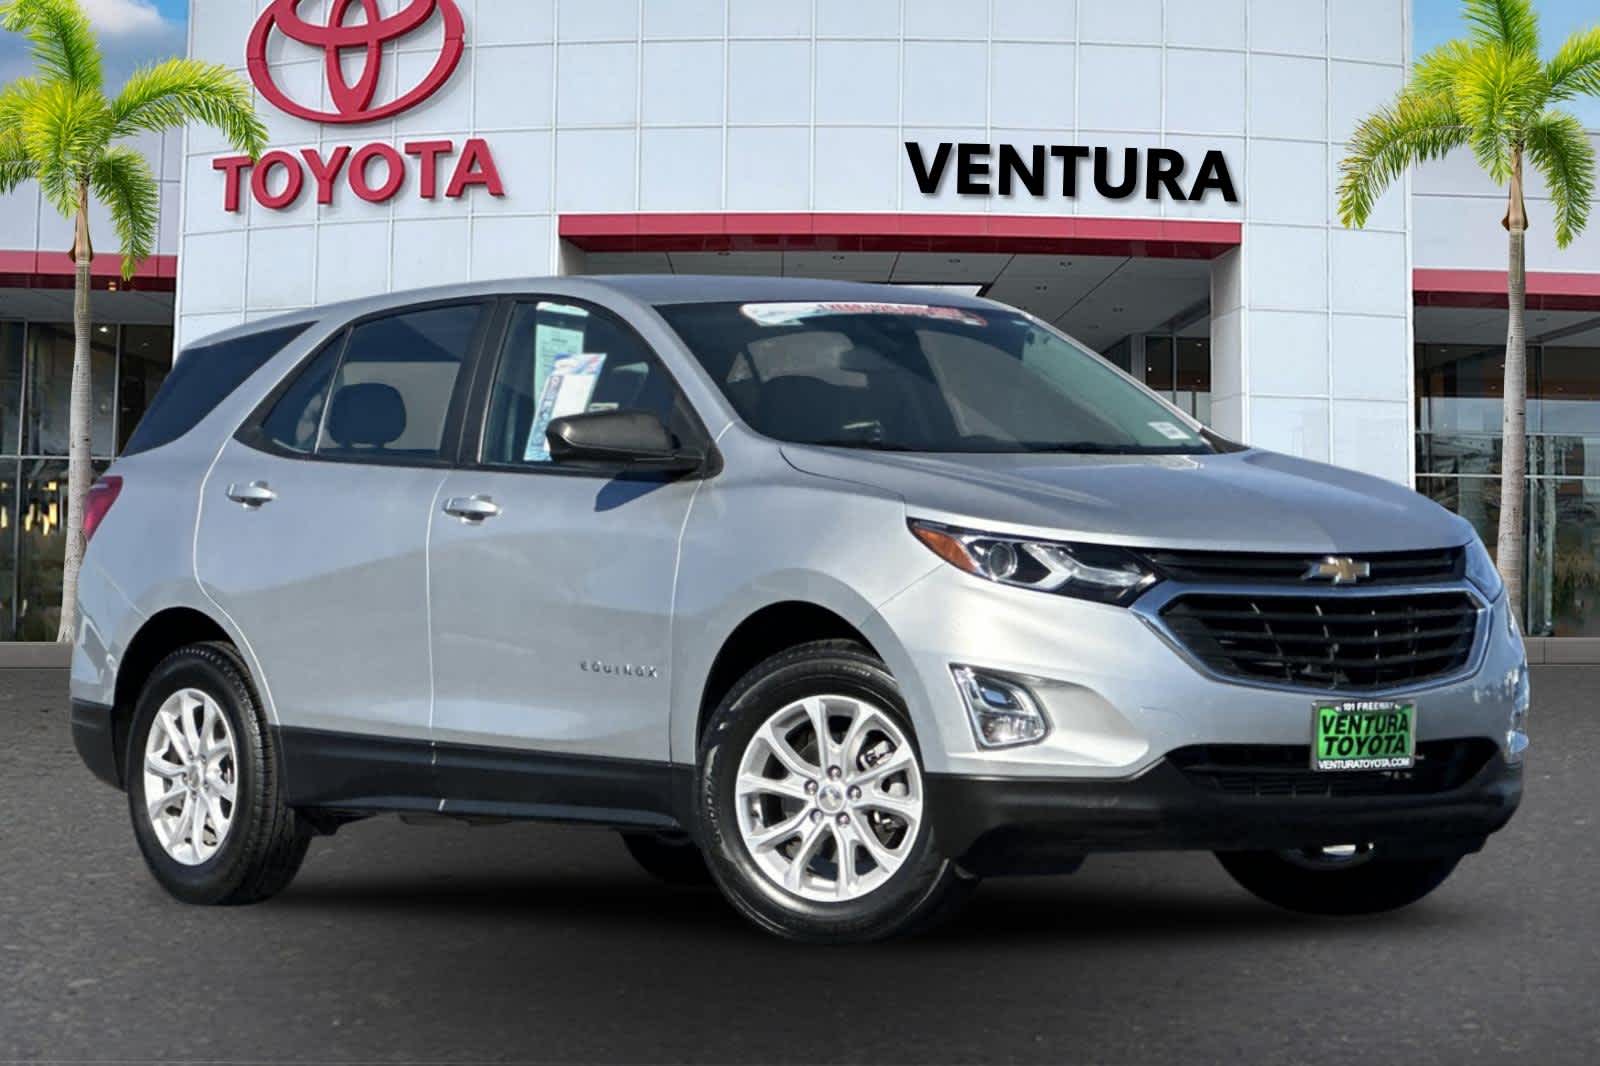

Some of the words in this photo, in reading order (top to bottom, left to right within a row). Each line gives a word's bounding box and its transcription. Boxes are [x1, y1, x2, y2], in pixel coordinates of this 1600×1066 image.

[212, 138, 505, 212] TOYOTA
[904, 142, 1239, 203] VENTURA
[580, 660, 658, 678] EQUINOX
[1322, 713, 1408, 735] VENTURA
[1324, 735, 1405, 755] TOYOTA
[1319, 758, 1410, 769] VENTURATOYOTA.COM
